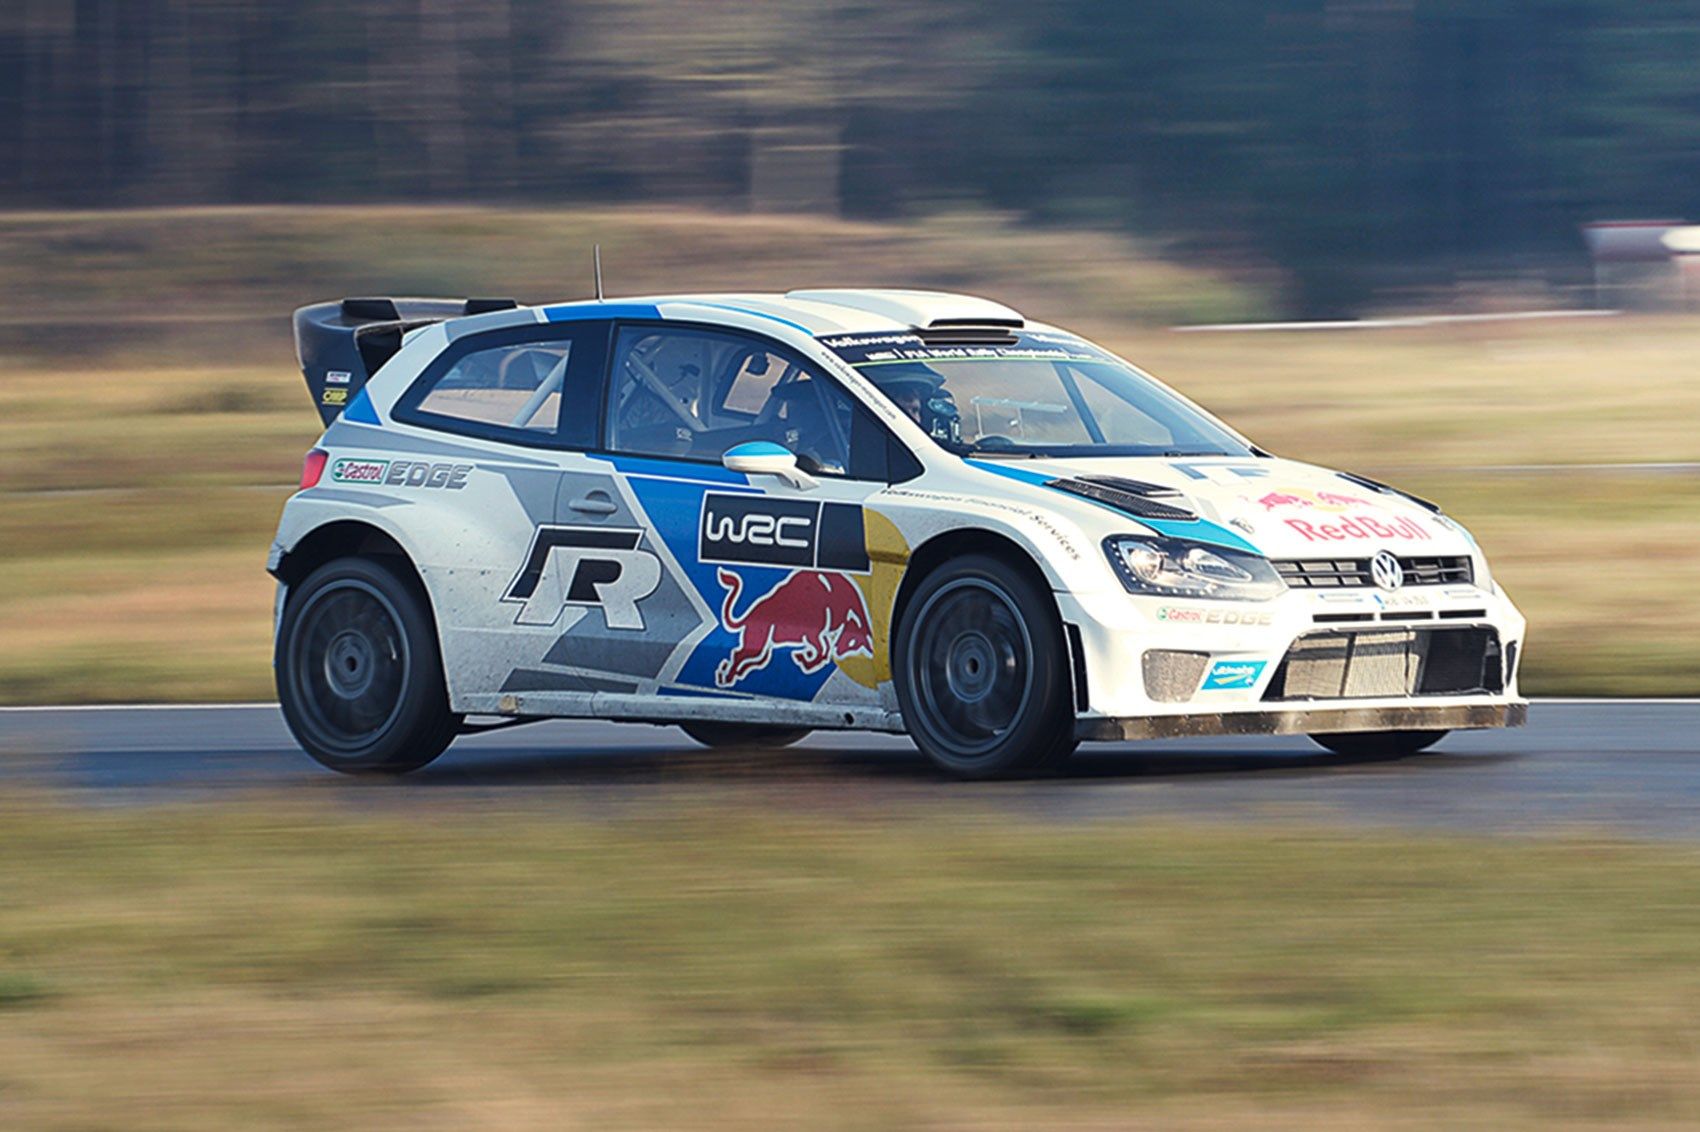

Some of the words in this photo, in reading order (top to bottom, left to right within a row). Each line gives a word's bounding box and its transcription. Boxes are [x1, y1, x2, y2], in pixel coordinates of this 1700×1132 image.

[342, 462, 386, 481] Castrol
[384, 461, 474, 490] EDGE
[706, 511, 811, 549] WRC
[1030, 513, 1083, 561] Services
